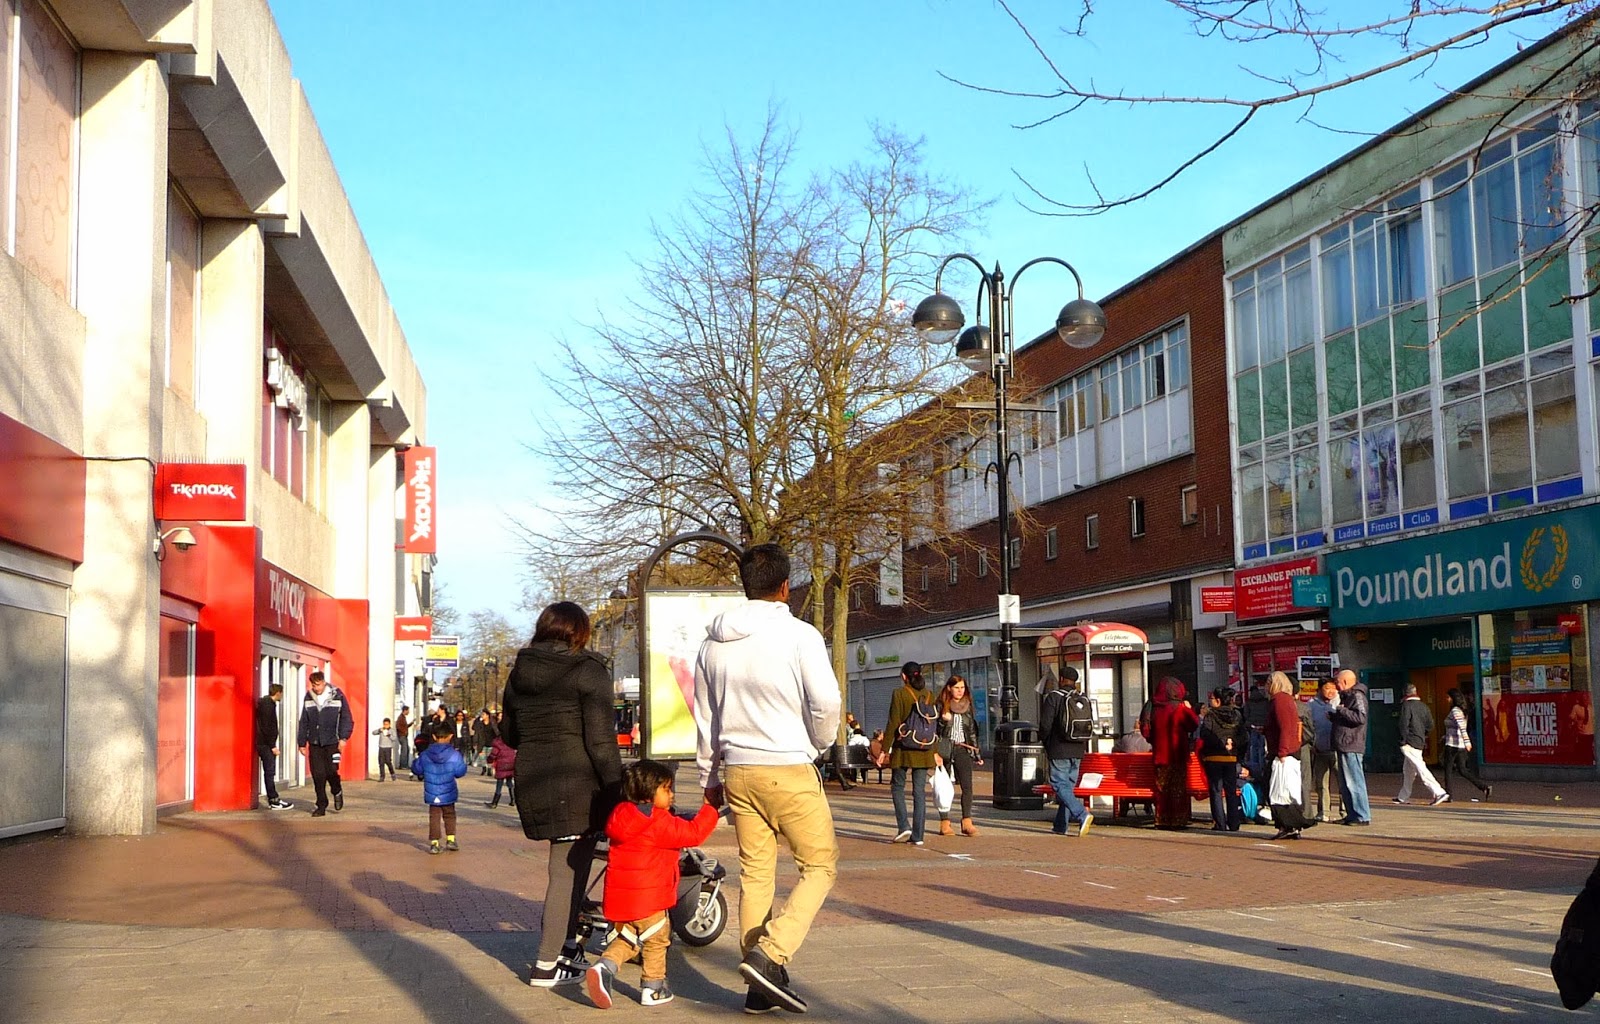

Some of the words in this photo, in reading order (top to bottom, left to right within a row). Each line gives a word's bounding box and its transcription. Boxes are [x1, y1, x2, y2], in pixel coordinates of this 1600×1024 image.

[1338, 528, 1361, 539] Ladies
[1371, 520, 1398, 532] Fitness
[1411, 513, 1431, 525] Club
[1241, 571, 1285, 587] EXCHANGE
[1285, 566, 1312, 579] POINT
[1296, 577, 1313, 586] yes!
[1336, 541, 1513, 609] Poundland
[1315, 593, 1327, 604] £1
[1431, 635, 1474, 650] Poundla
[1515, 702, 1556, 716] AMAZING
[1516, 715, 1558, 735] VALUE
[1518, 734, 1558, 747] EVERYDAY!
